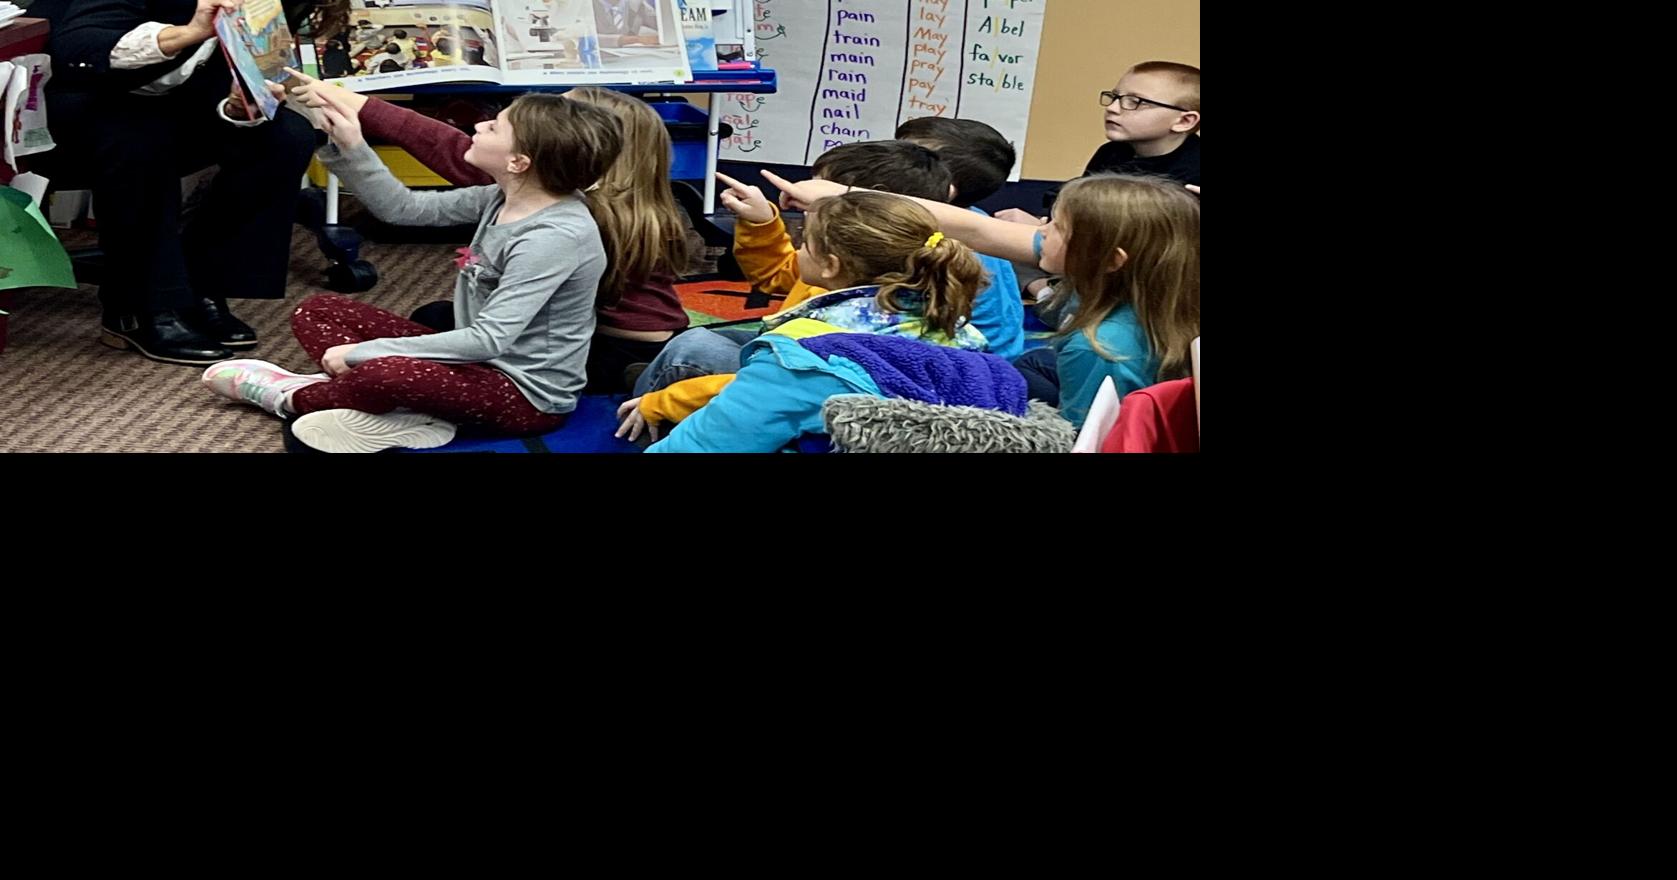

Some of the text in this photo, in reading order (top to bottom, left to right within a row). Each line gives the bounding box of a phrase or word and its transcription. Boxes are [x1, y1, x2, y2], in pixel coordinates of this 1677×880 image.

[837, 10, 875, 26] pain
[919, 7, 946, 28] lay
[833, 30, 880, 47] train
[913, 27, 948, 48] May
[830, 52, 875, 66] main
[914, 44, 946, 65] play
[828, 69, 867, 84] rain
[910, 60, 945, 82] pray
[822, 88, 866, 102] maid
[908, 79, 935, 98] pay
[823, 104, 859, 119] nail
[908, 96, 946, 117] tray
[820, 122, 870, 139] chain
